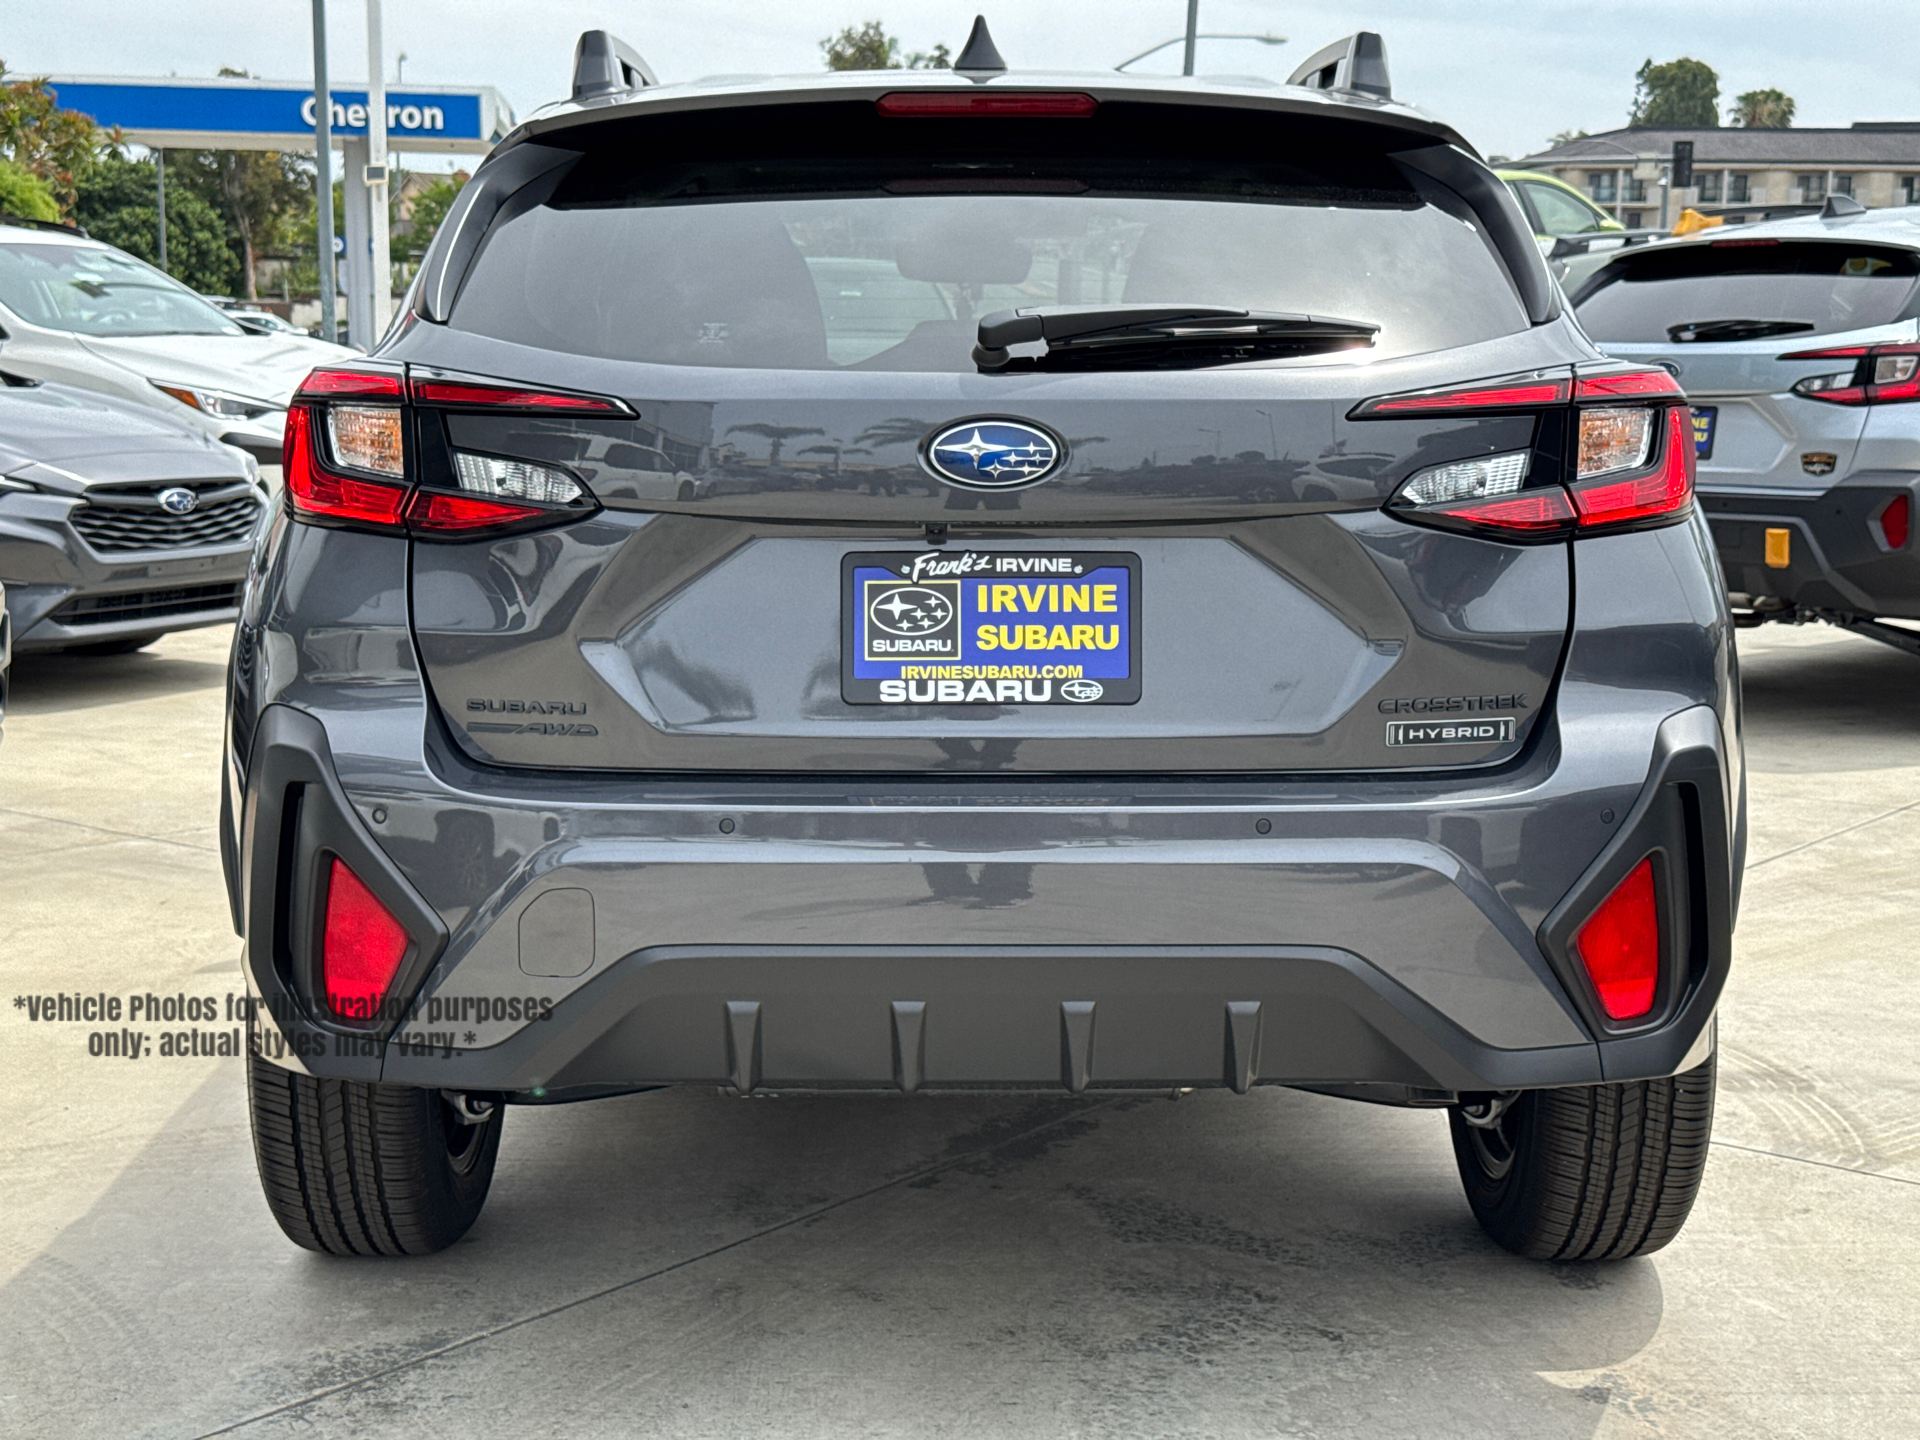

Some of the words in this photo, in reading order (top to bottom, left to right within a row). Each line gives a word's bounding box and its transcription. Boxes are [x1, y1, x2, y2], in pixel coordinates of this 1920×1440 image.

[301, 96, 444, 130] Cheron
[912, 552, 993, 583] Frank's
[995, 558, 1073, 573] IRVINE
[977, 584, 1118, 613] IRVINE
[872, 639, 952, 652] SUBARU
[976, 624, 1119, 650] SUBARU
[901, 665, 1083, 679] IRVINESUBARU.COM
[879, 680, 1052, 703] SUBARU
[466, 699, 587, 715] SUBARU
[1378, 694, 1528, 714] CROSSTREK
[515, 722, 599, 736] AWD
[1409, 726, 1495, 740] HYBRID
